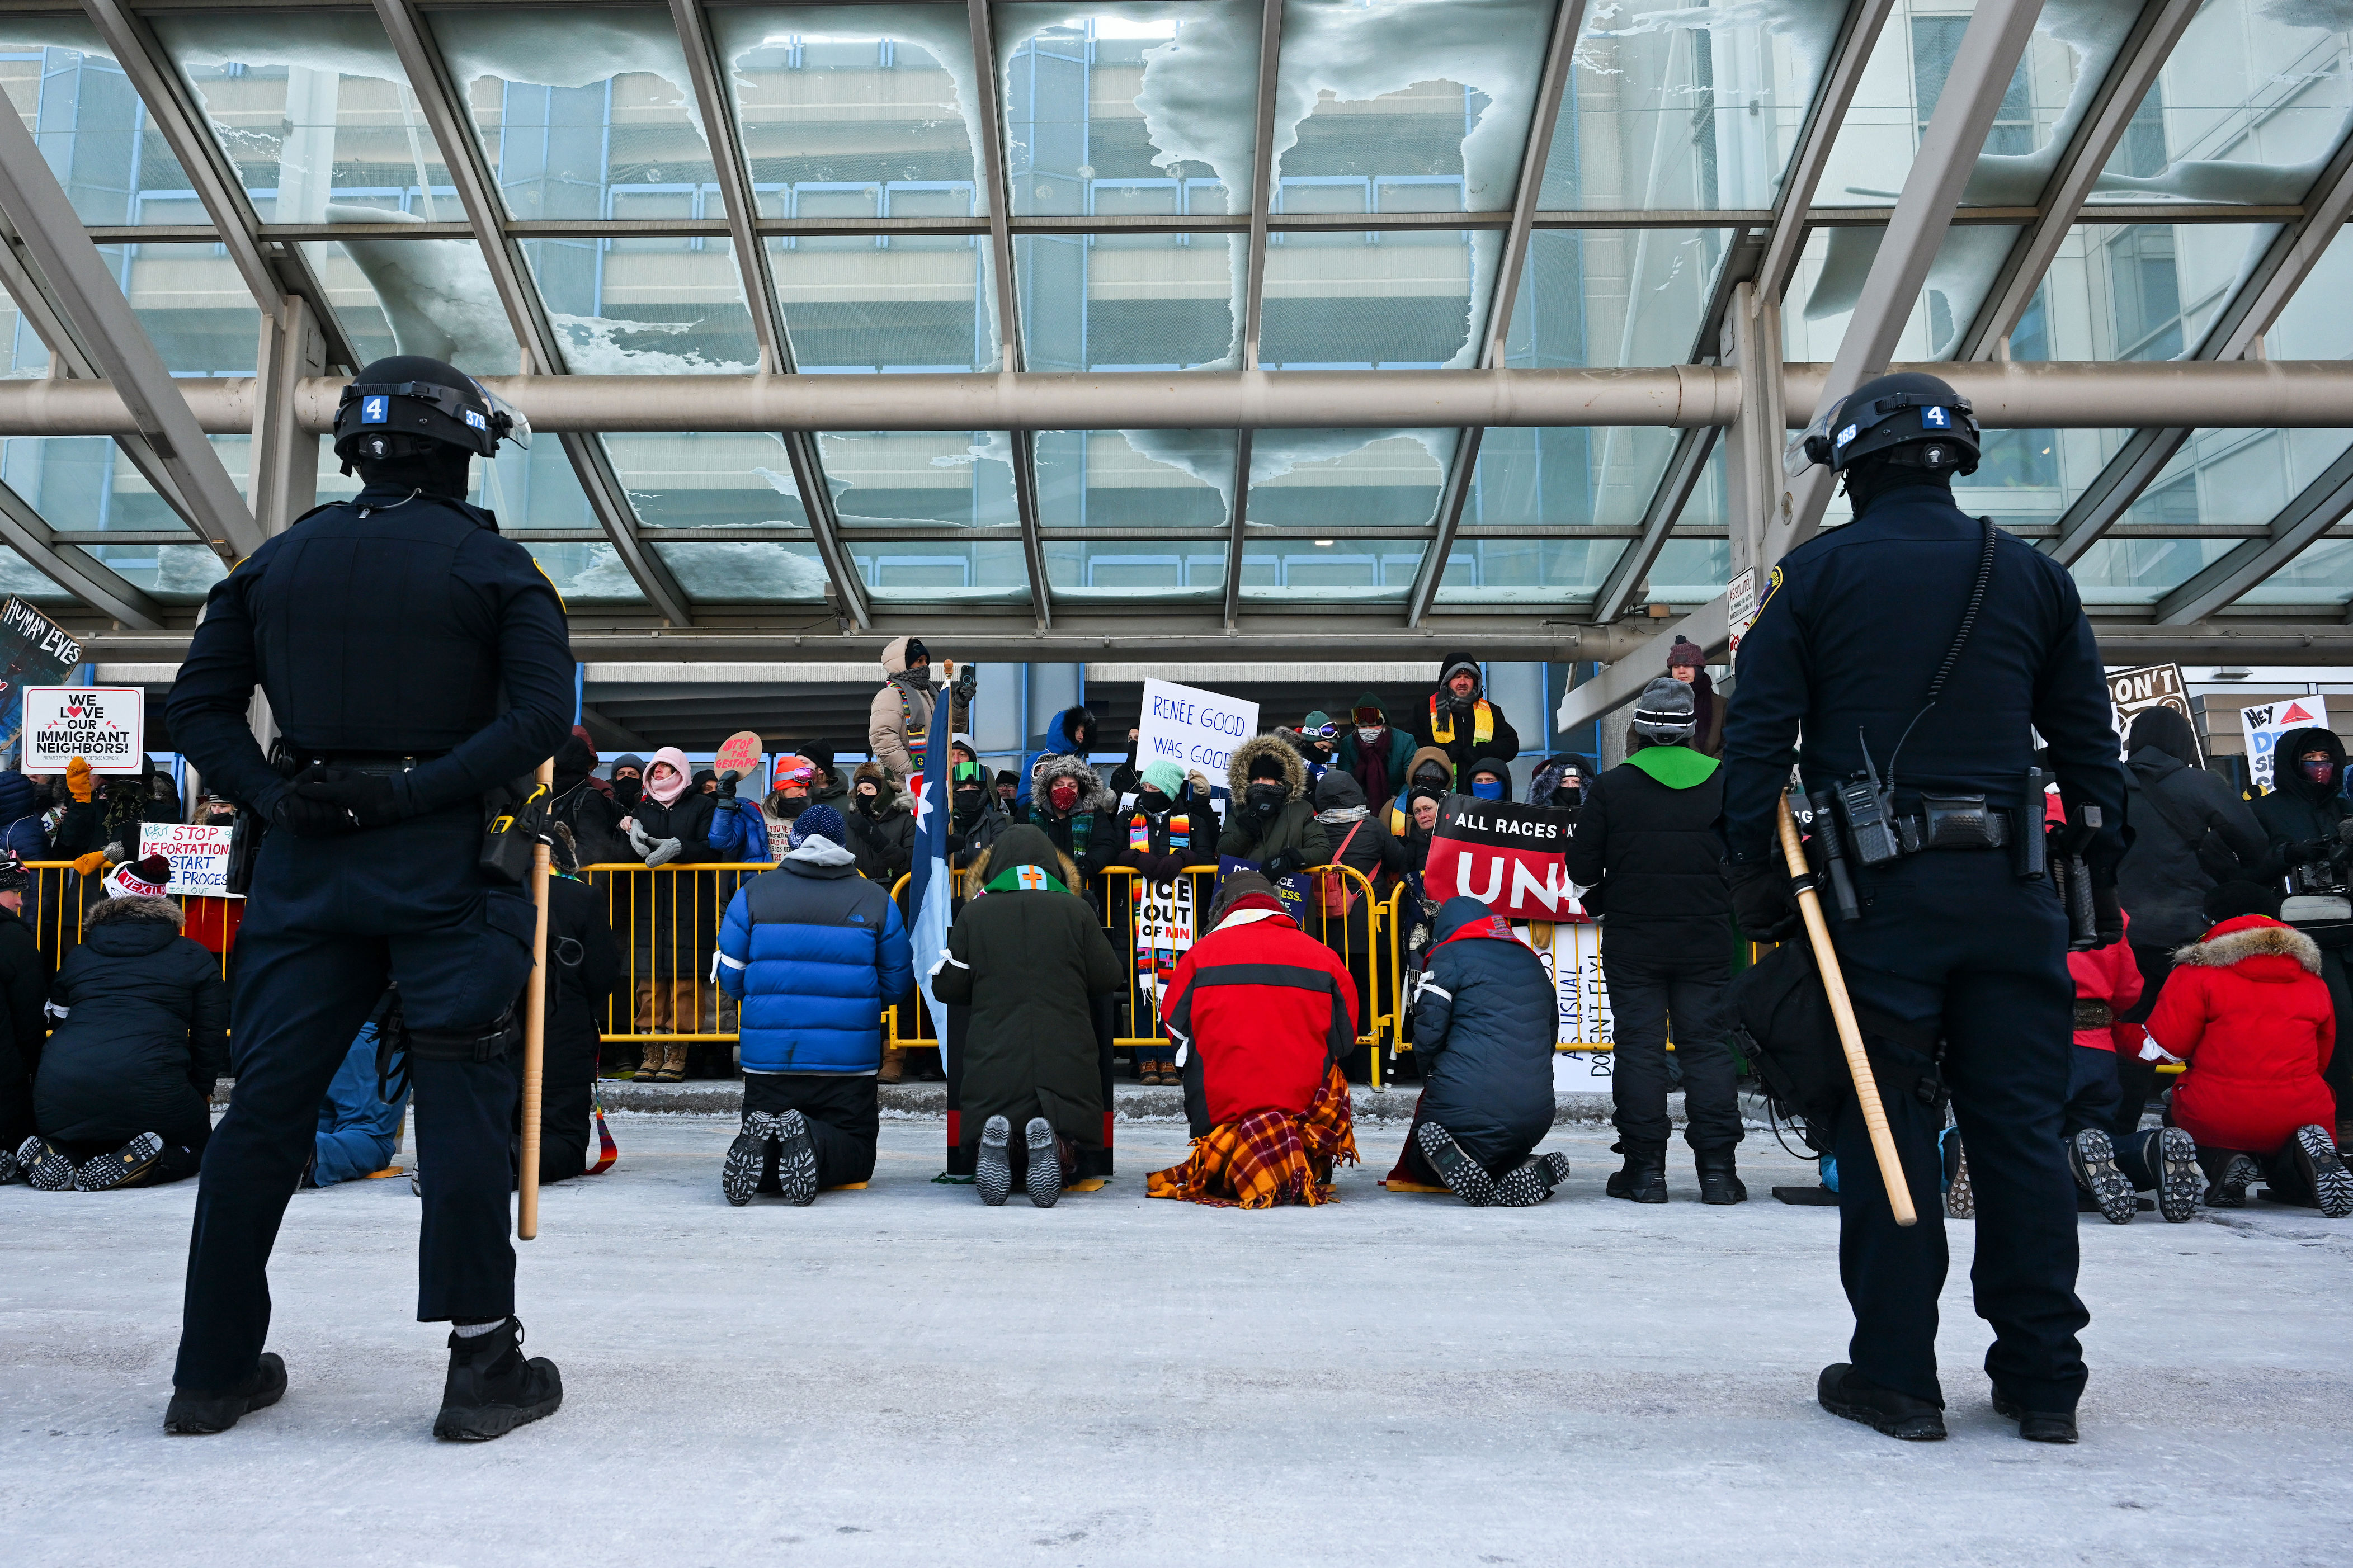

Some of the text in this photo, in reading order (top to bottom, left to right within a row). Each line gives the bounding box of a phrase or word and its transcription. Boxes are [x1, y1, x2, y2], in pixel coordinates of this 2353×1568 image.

[366, 398, 381, 419] 4
[1928, 407, 1944, 425] 4
[466, 410, 485, 430] 379
[1837, 425, 1856, 447] 365
[1730, 576, 1752, 602] ABSOLUTELY
[3, 597, 81, 664] HUMAN LIVES
[69, 695, 96, 706] WE
[1154, 696, 1244, 736] RENÉE GOOD
[2244, 706, 2274, 729] HEY
[67, 720, 97, 729] OUR
[37, 731, 129, 743] IMMIGRANT
[723, 738, 754, 752] STOP
[37, 743, 128, 753] NEIGHBORS!
[1153, 736, 1231, 770] WAS GOOD
[716, 758, 757, 768] GESTAPO
[145, 824, 160, 837] ICE
[151, 825, 169, 840] OUT
[173, 826, 218, 841] STOP
[770, 825, 788, 833] YOU'VE
[1455, 813, 1488, 830] ALL
[1496, 819, 1557, 838] RACES
[169, 856, 215, 870] START
[182, 871, 227, 885] PROCES
[1145, 880, 1190, 903] ICE
[1143, 905, 1190, 924] OUT
[1142, 925, 1190, 939] OF MN
[1560, 966, 1583, 1024] USUAL
